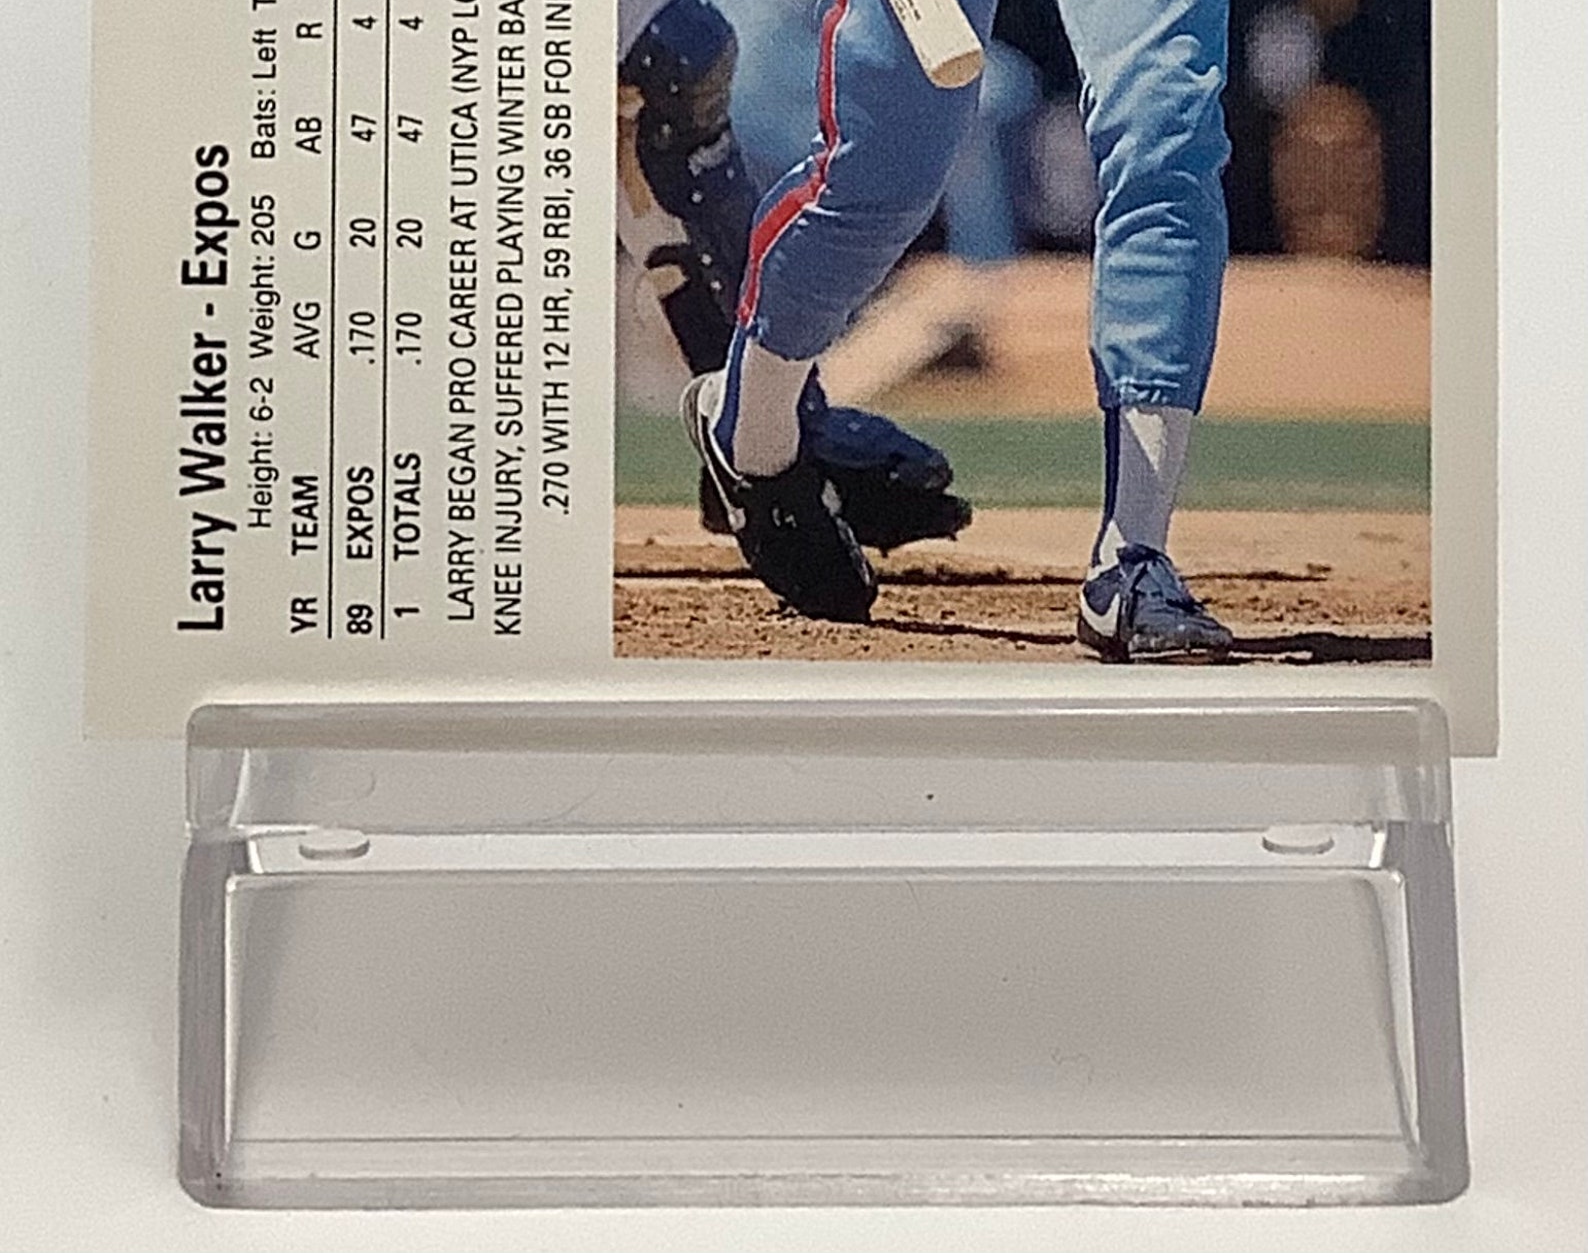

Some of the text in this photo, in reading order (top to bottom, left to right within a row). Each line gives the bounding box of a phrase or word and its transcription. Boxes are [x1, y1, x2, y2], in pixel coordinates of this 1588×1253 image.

[294, 21, 324, 40] R
[351, 14, 380, 31] 4
[397, 15, 425, 32] 4
[250, 27, 278, 80] Left
[449, 26, 483, 94] (NYP
[543, 39, 573, 95] FOR
[249, 88, 277, 160] Bats:
[349, 113, 378, 144] 47
[396, 113, 424, 145] 47
[496, 44, 526, 158] WINTER
[542, 102, 573, 141] SB
[293, 115, 323, 156] AB
[449, 100, 479, 187] UTICA
[543, 147, 573, 180] 36
[180, 143, 242, 287] Expos
[249, 194, 276, 248] 205
[292, 230, 323, 252] G
[347, 217, 378, 249] 20
[394, 217, 424, 250] 20
[449, 194, 479, 232] AT
[494, 163, 526, 285] PLAYING
[542, 187, 576, 240] RBI,
[542, 246, 572, 280] 59
[247, 254, 282, 360] Weight:
[447, 237, 478, 350] CAREER
[541, 286, 575, 334] HR,
[290, 301, 322, 361] AVG
[347, 310, 377, 366] .170
[394, 311, 423, 366] .170
[541, 341, 571, 372] 12
[447, 356, 478, 415] PRO
[493, 291, 526, 438] SUFFERED
[177, 331, 229, 498] Walker
[247, 376, 275, 423] 6-2
[540, 380, 571, 455] WITH
[245, 430, 281, 529] Height:
[446, 422, 478, 522] BEGAN
[493, 444, 529, 554] INJURY,
[541, 460, 571, 516] .270
[290, 474, 321, 558] TEAM
[344, 465, 376, 561] EXPOS
[391, 451, 422, 563] TOTALS
[176, 510, 239, 632] Larry
[446, 528, 478, 622] LARRY
[492, 562, 523, 636] KNEE
[289, 595, 319, 635] YR
[345, 603, 375, 636] 89
[392, 606, 421, 619] 1
